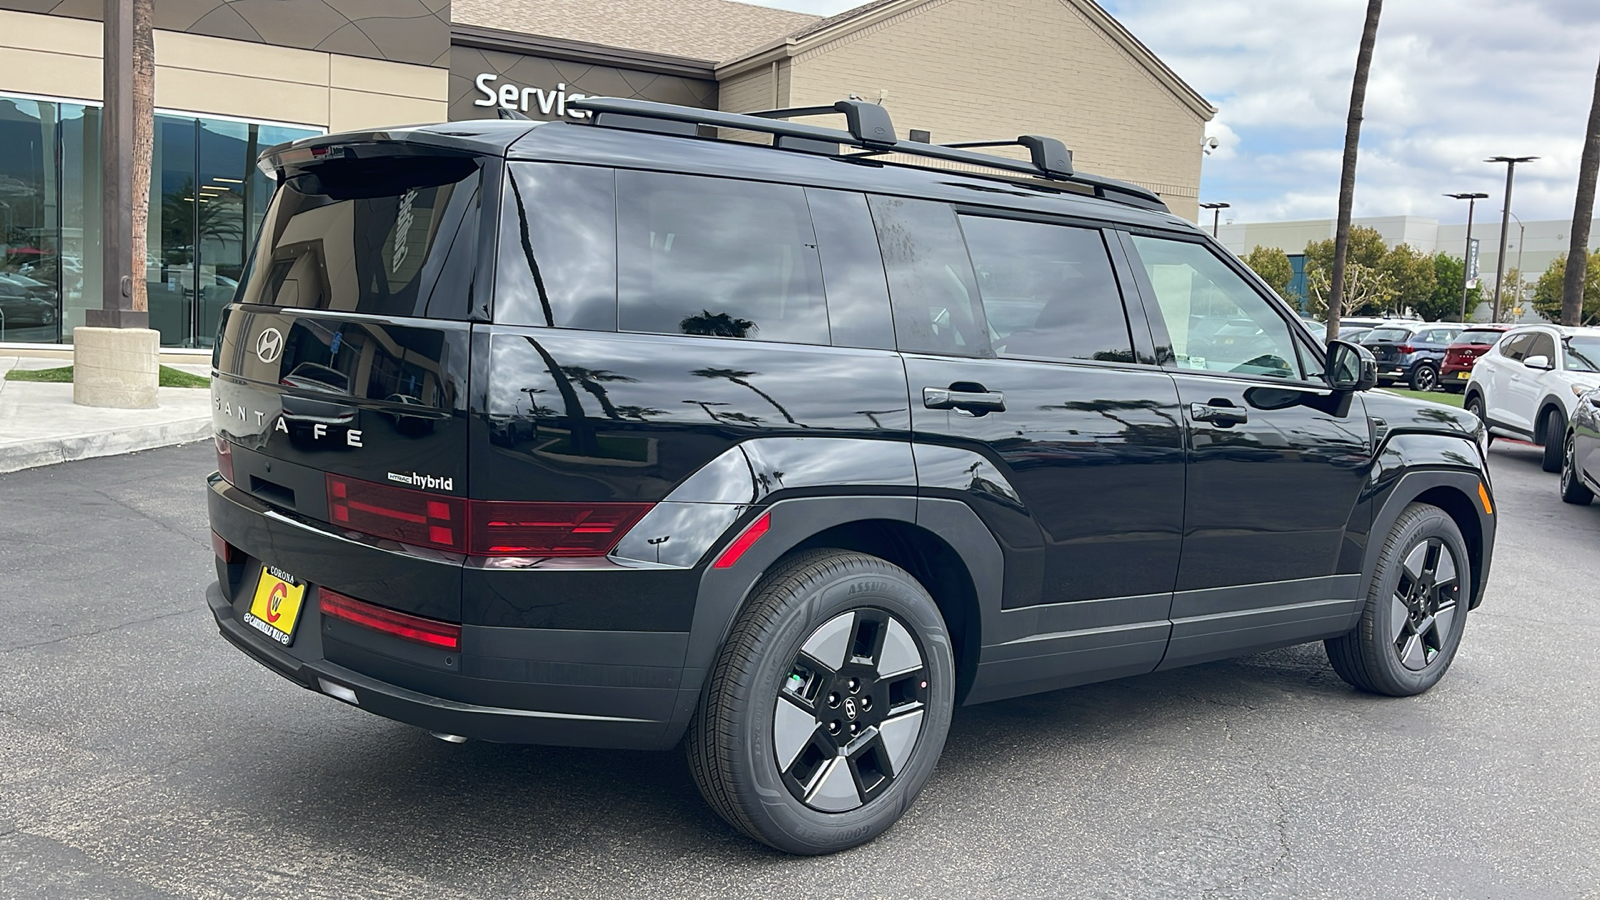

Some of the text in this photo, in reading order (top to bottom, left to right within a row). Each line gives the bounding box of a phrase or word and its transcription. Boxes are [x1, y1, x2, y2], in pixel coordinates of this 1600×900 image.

[474, 73, 599, 118] Servic
[215, 396, 363, 448] SANTA FE
[413, 471, 453, 491] hybrid
[270, 565, 295, 584] CORONA
